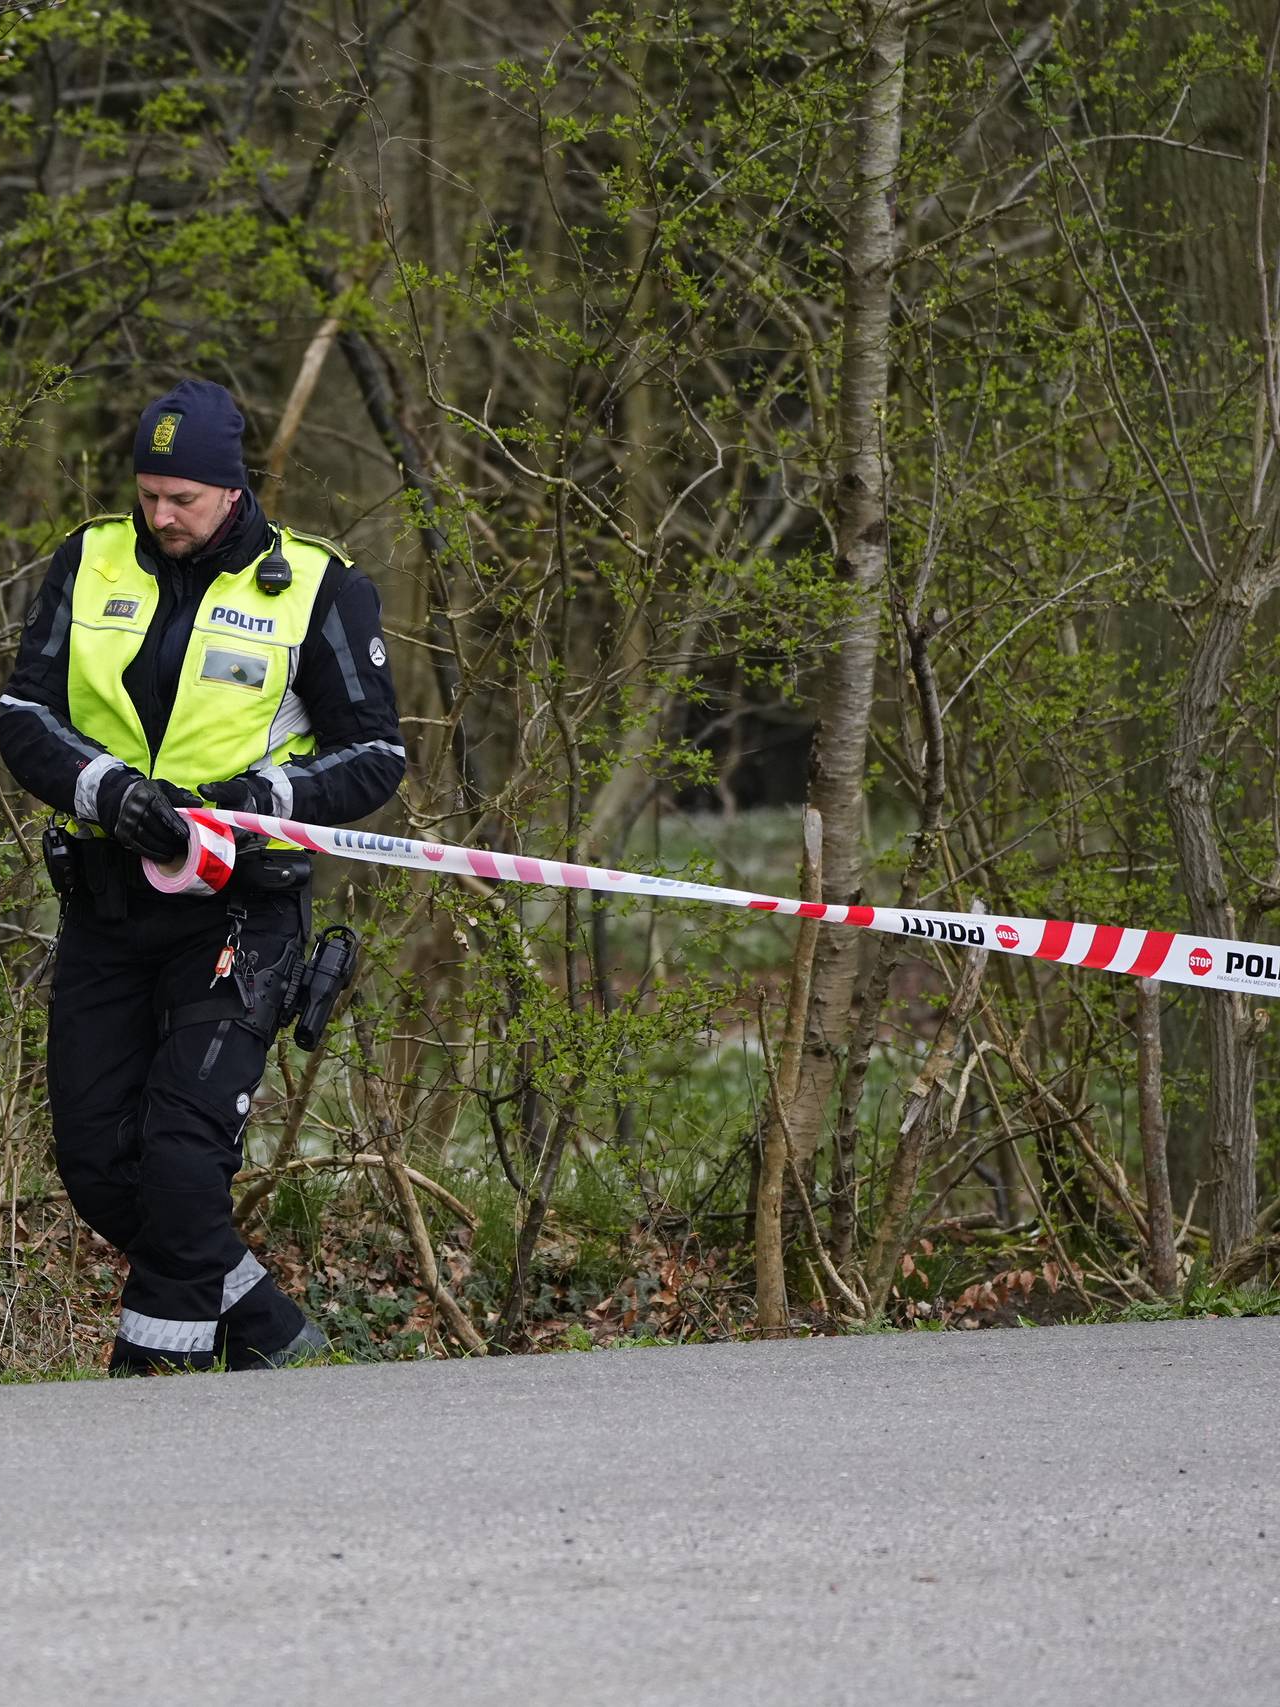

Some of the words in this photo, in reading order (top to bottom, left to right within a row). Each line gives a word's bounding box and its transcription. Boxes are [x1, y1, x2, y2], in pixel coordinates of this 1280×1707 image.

[211, 607, 273, 633] POLITI
[900, 915, 985, 946] POLITI
[996, 931, 1019, 941] STOP
[1189, 956, 1212, 968] STOP
